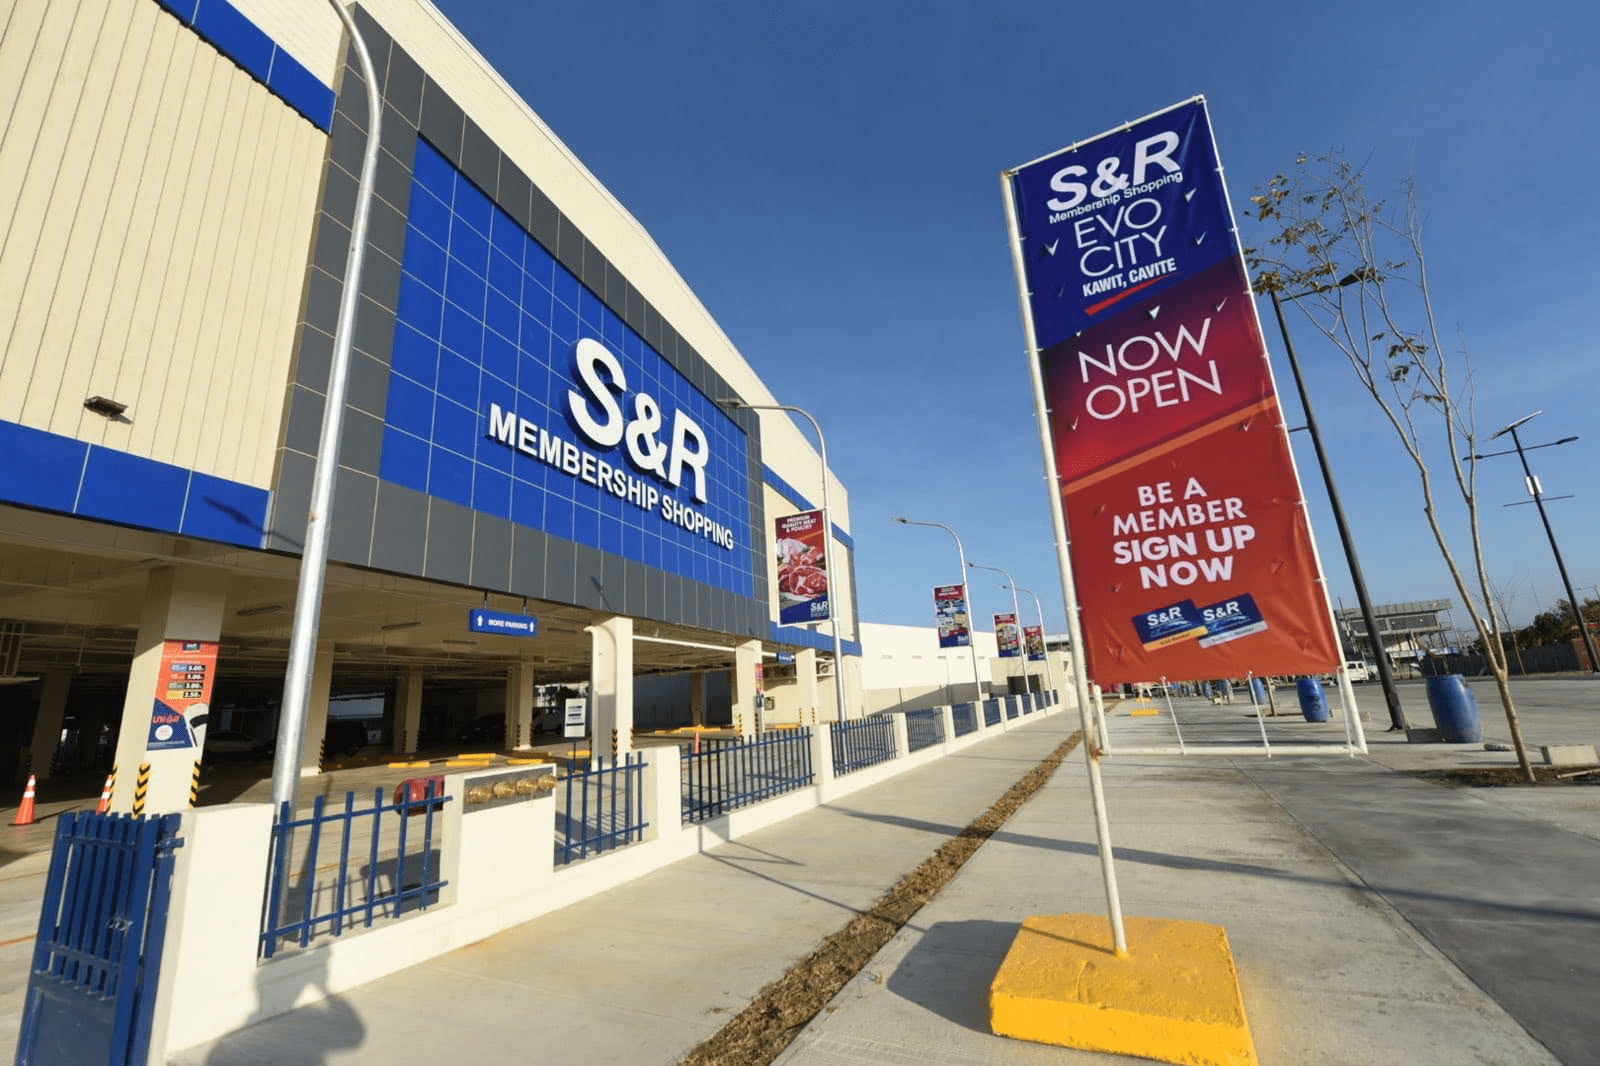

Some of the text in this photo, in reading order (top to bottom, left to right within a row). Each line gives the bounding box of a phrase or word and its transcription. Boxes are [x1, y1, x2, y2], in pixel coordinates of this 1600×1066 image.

[1047, 131, 1181, 211] S&R
[1049, 170, 1183, 224] Membership Shopping
[1073, 198, 1162, 249] EVO
[1080, 225, 1167, 277] CITY
[1082, 258, 1177, 297] KAWIT, CAVITE
[1077, 317, 1211, 383] NOW
[1085, 359, 1222, 420] OPEN
[568, 337, 710, 503] S&R
[488, 403, 734, 550] MEMBERSHIP SHOPPING
[1137, 477, 1207, 507] BE A
[1112, 497, 1247, 536] MEMBER
[1112, 524, 1256, 565] SIGN UP
[1139, 556, 1233, 590] NOW
[1147, 606, 1183, 626] S&R
[1202, 601, 1240, 621] S&R
